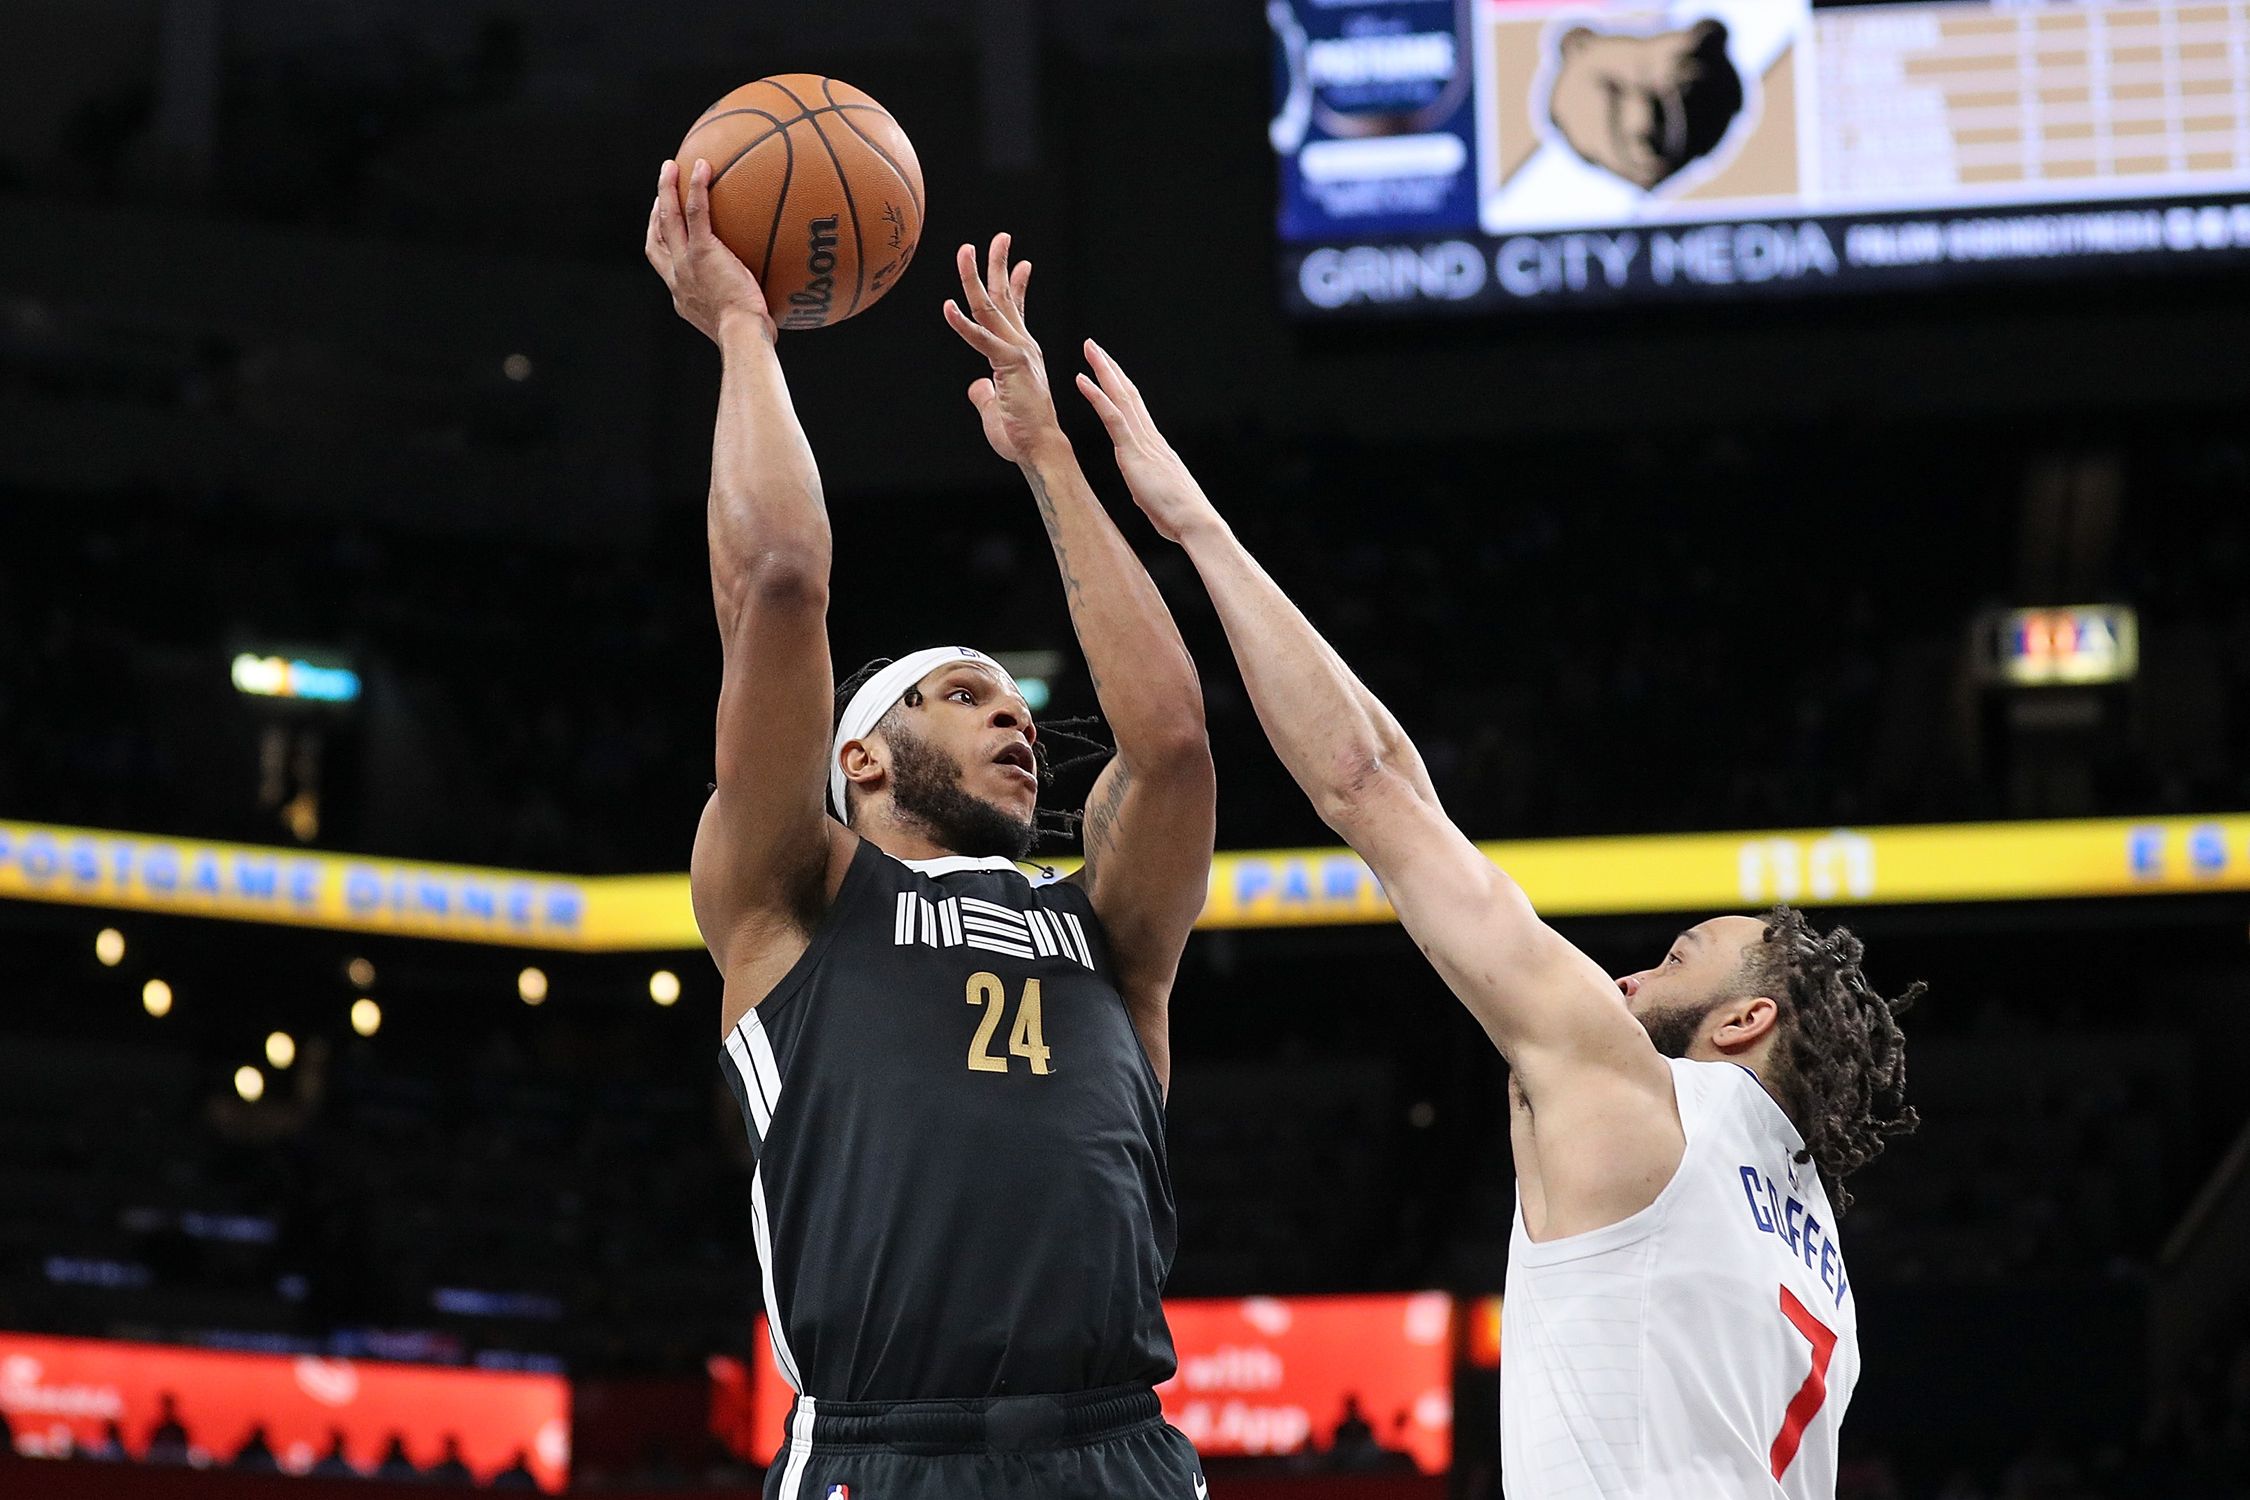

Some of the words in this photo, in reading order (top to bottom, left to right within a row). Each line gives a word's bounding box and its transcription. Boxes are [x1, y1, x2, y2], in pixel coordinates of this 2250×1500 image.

[1301, 240, 1487, 307] GRIND
[1497, 232, 1640, 297] CITY
[1650, 220, 1839, 287] MEDIA
[344, 863, 582, 931] DINNER
[1234, 858, 1382, 904] PAR
[966, 971, 1051, 1075] 24
[1739, 1165, 1847, 1310] COFFEY
[1770, 1283, 1838, 1483] 7
